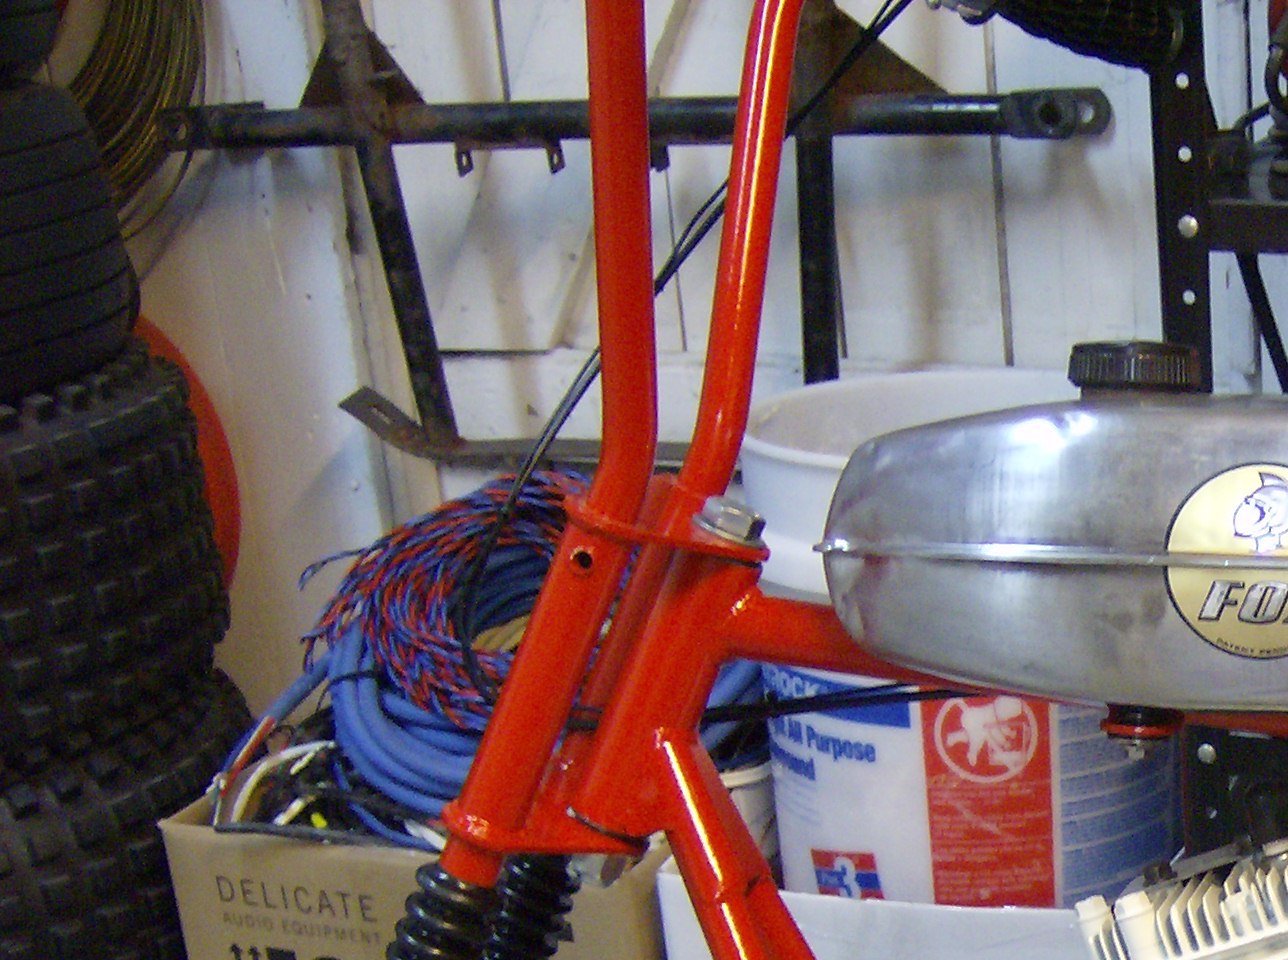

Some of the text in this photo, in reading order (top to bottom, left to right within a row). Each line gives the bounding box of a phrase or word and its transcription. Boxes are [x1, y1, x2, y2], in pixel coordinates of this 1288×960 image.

[806, 725, 876, 762] Purpose
[215, 875, 377, 922] DELICATE
[223, 912, 381, 944] AUDIO EQUIPMENT
